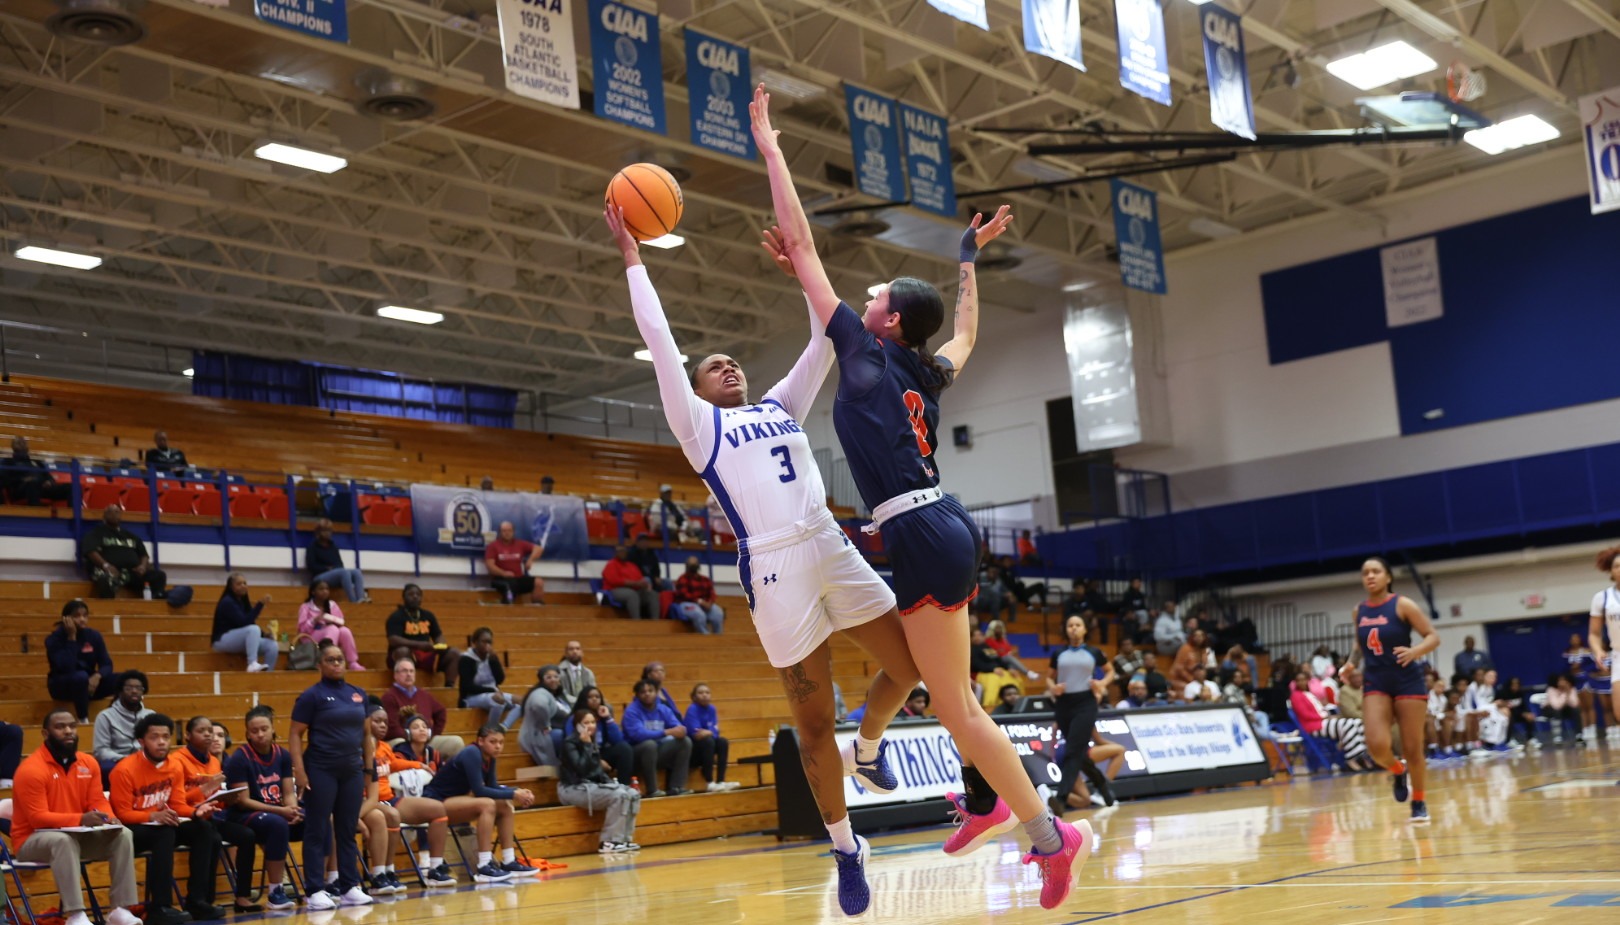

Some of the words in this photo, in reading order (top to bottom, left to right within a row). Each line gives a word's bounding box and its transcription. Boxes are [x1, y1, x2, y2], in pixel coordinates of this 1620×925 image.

[261, 2, 332, 35] CHAMPIONS
[521, 10, 551, 33] 1978
[601, 4, 648, 43] CIAA
[1204, 12, 1239, 52] CIAA
[514, 44, 562, 68] ATLANTIC
[519, 32, 554, 51] SOUTH
[506, 54, 571, 83] BASKETBALL
[697, 41, 739, 77] CIAA
[509, 71, 570, 98] CHAMPIONS
[612, 62, 642, 86] 2002
[604, 103, 655, 128] CHAMPIONS
[606, 91, 652, 115] SOFTBALL
[853, 95, 890, 128] CIAA
[904, 110, 943, 140] NAIA
[701, 133, 747, 155] CHAMPIONS
[1118, 187, 1153, 222] CIAA
[724, 419, 804, 449] VIKING
[770, 444, 797, 483] 3
[457, 511, 480, 535] 50
[1367, 627, 1384, 656] 4
